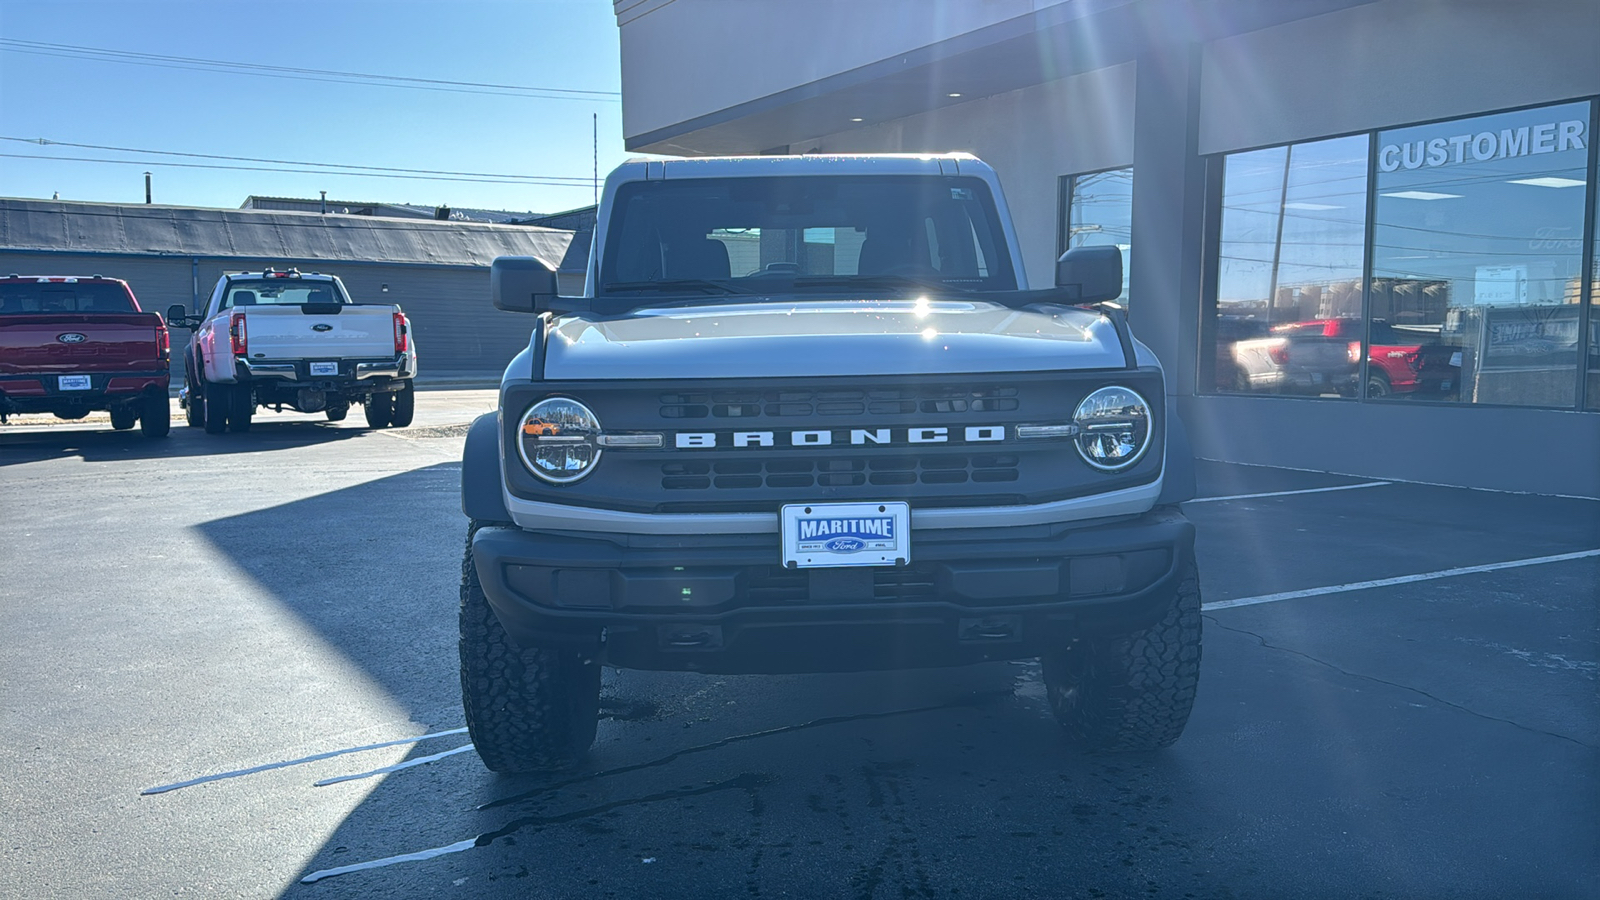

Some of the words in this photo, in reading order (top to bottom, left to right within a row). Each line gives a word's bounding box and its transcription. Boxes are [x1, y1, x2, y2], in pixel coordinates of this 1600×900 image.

[1379, 119, 1587, 172] CUSTOMER
[675, 426, 1005, 448] BRONCO
[800, 519, 892, 540] MARITIME
[832, 540, 859, 550] Ford
